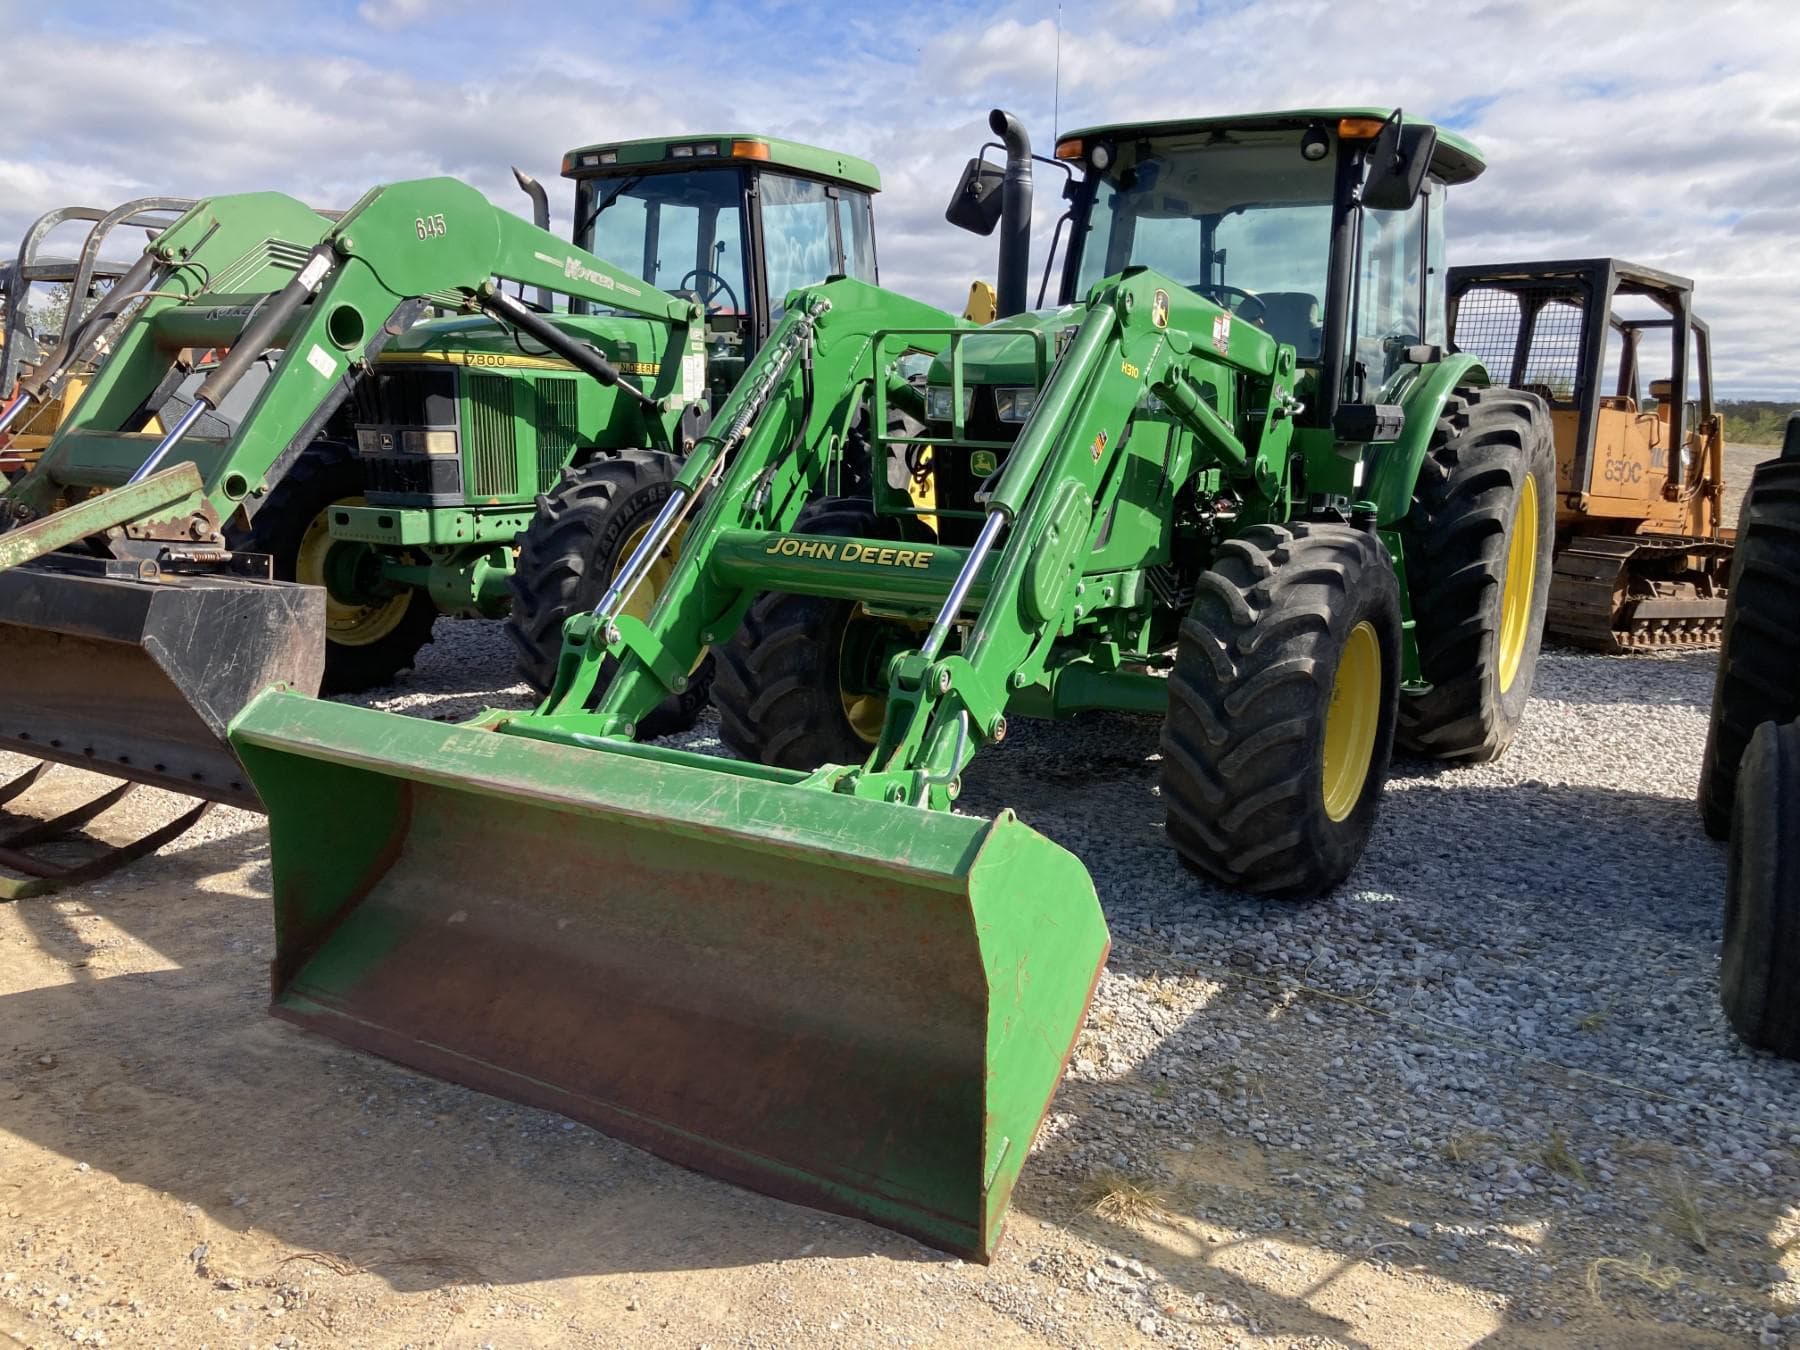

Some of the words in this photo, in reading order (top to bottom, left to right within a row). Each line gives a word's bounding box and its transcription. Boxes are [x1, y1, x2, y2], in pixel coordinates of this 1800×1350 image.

[415, 213, 446, 241] 645
[466, 354, 505, 366] 7800
[1604, 459, 1642, 484] 650C
[766, 537, 837, 560] JOHN
[839, 543, 934, 569] DEERE
